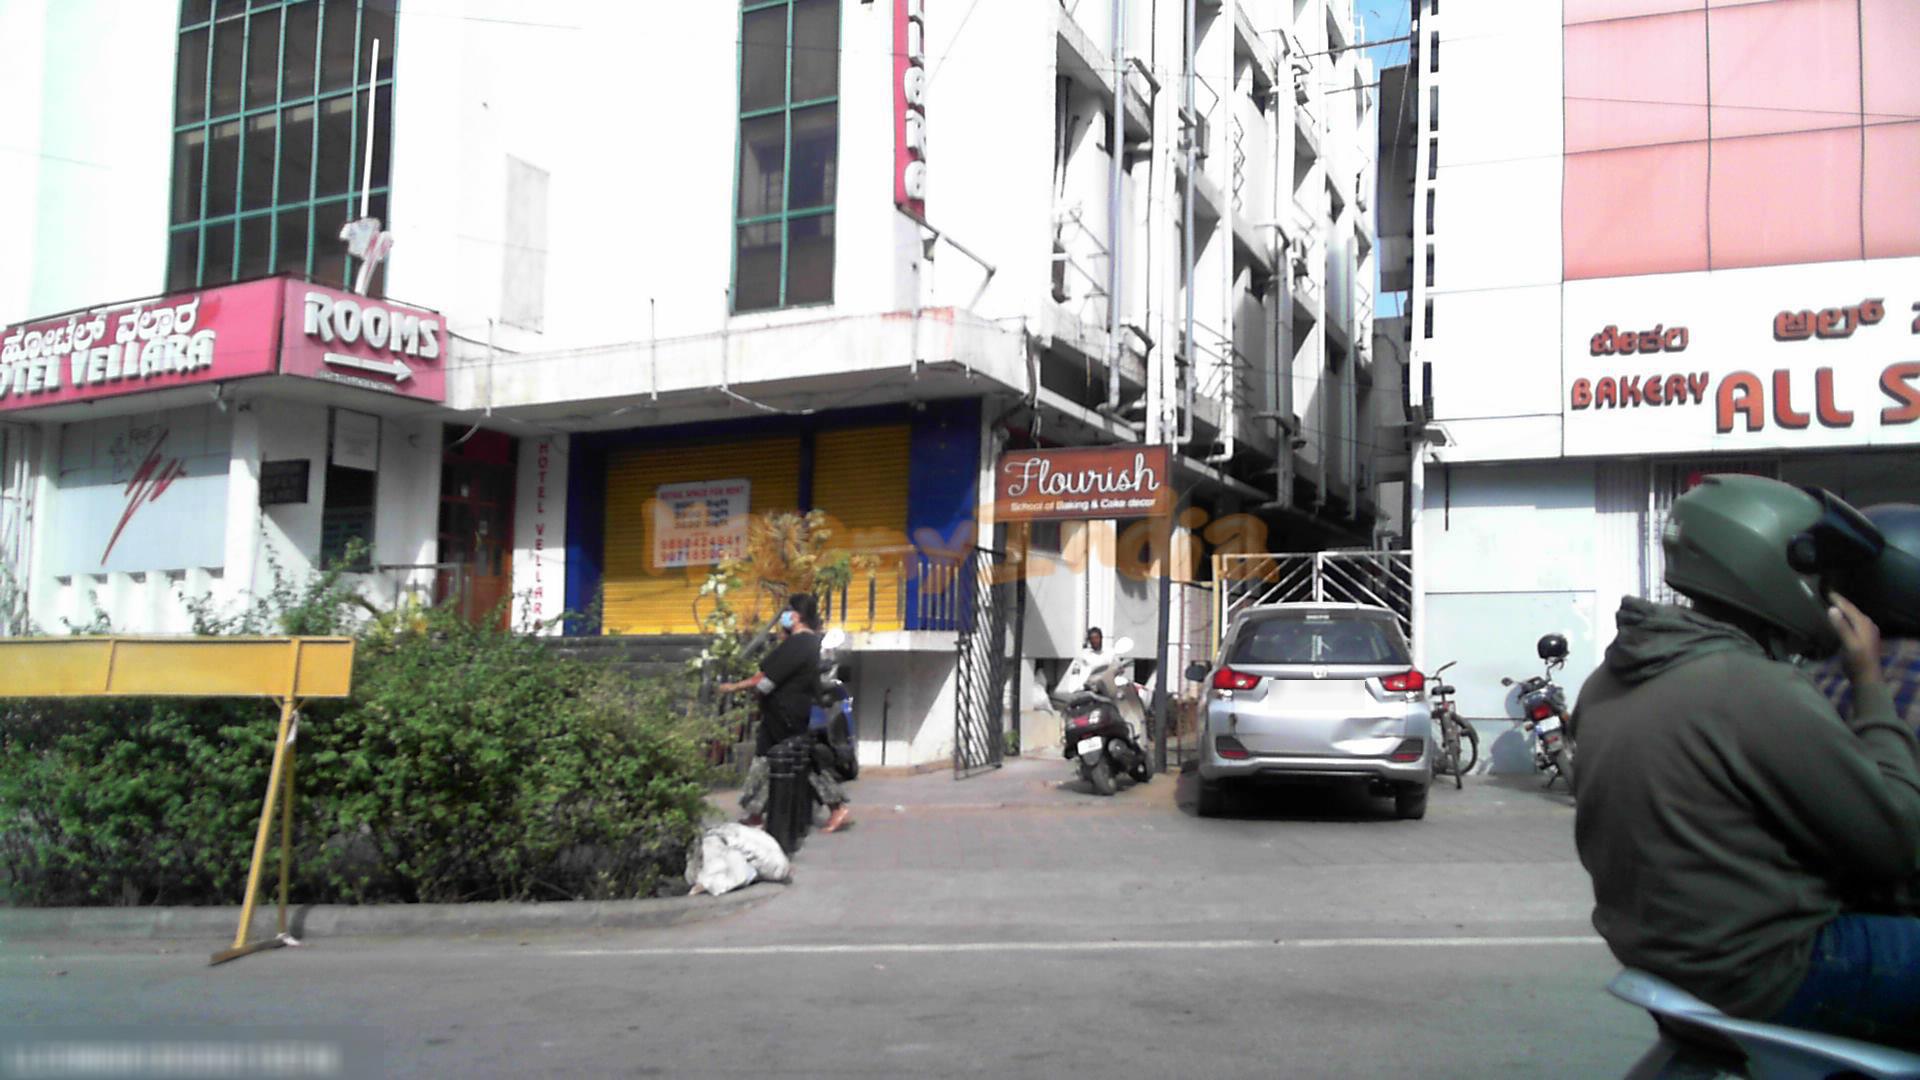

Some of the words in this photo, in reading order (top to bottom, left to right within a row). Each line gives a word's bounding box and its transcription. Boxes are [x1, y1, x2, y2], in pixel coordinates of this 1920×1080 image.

[304, 291, 440, 360] ROOMS
[70, 330, 216, 387] VELLARA
[1571, 371, 1709, 410] BAKERY
[1716, 367, 1854, 434] ALL
[536, 442, 549, 514] HOTEL
[1004, 452, 1160, 497] Flourish
[1011, 501, 1043, 512] School
[1044, 500, 1055, 510] of
[1056, 499, 1089, 512] Baking
[1091, 500, 1099, 508] &
[1100, 499, 1126, 508] Cake
